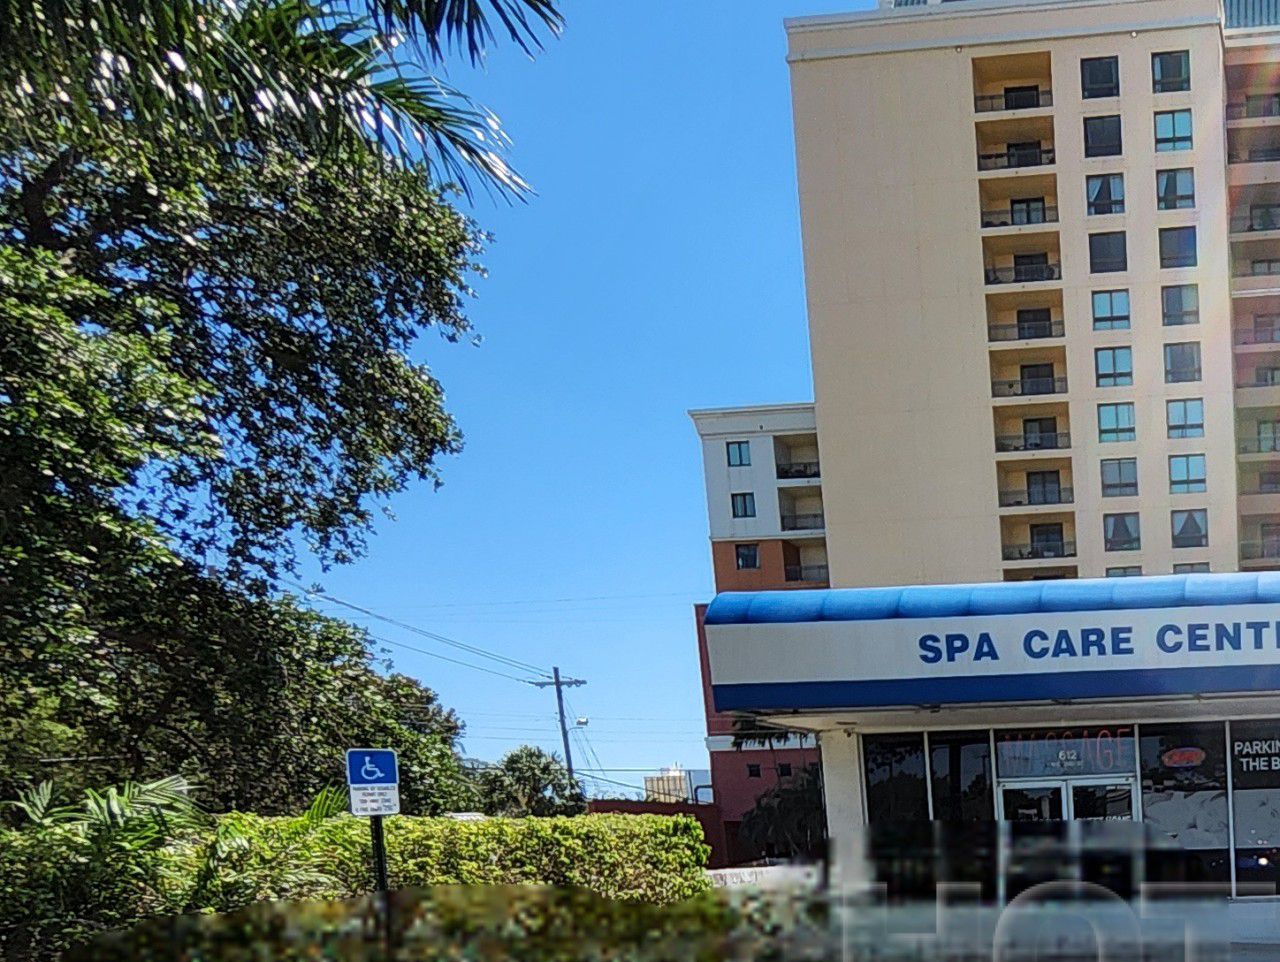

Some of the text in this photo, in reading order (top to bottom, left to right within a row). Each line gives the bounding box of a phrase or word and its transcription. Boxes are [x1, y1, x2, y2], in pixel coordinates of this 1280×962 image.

[919, 633, 998, 663] SPA
[1023, 627, 1135, 659] CARE
[1239, 757, 1269, 771] THE
